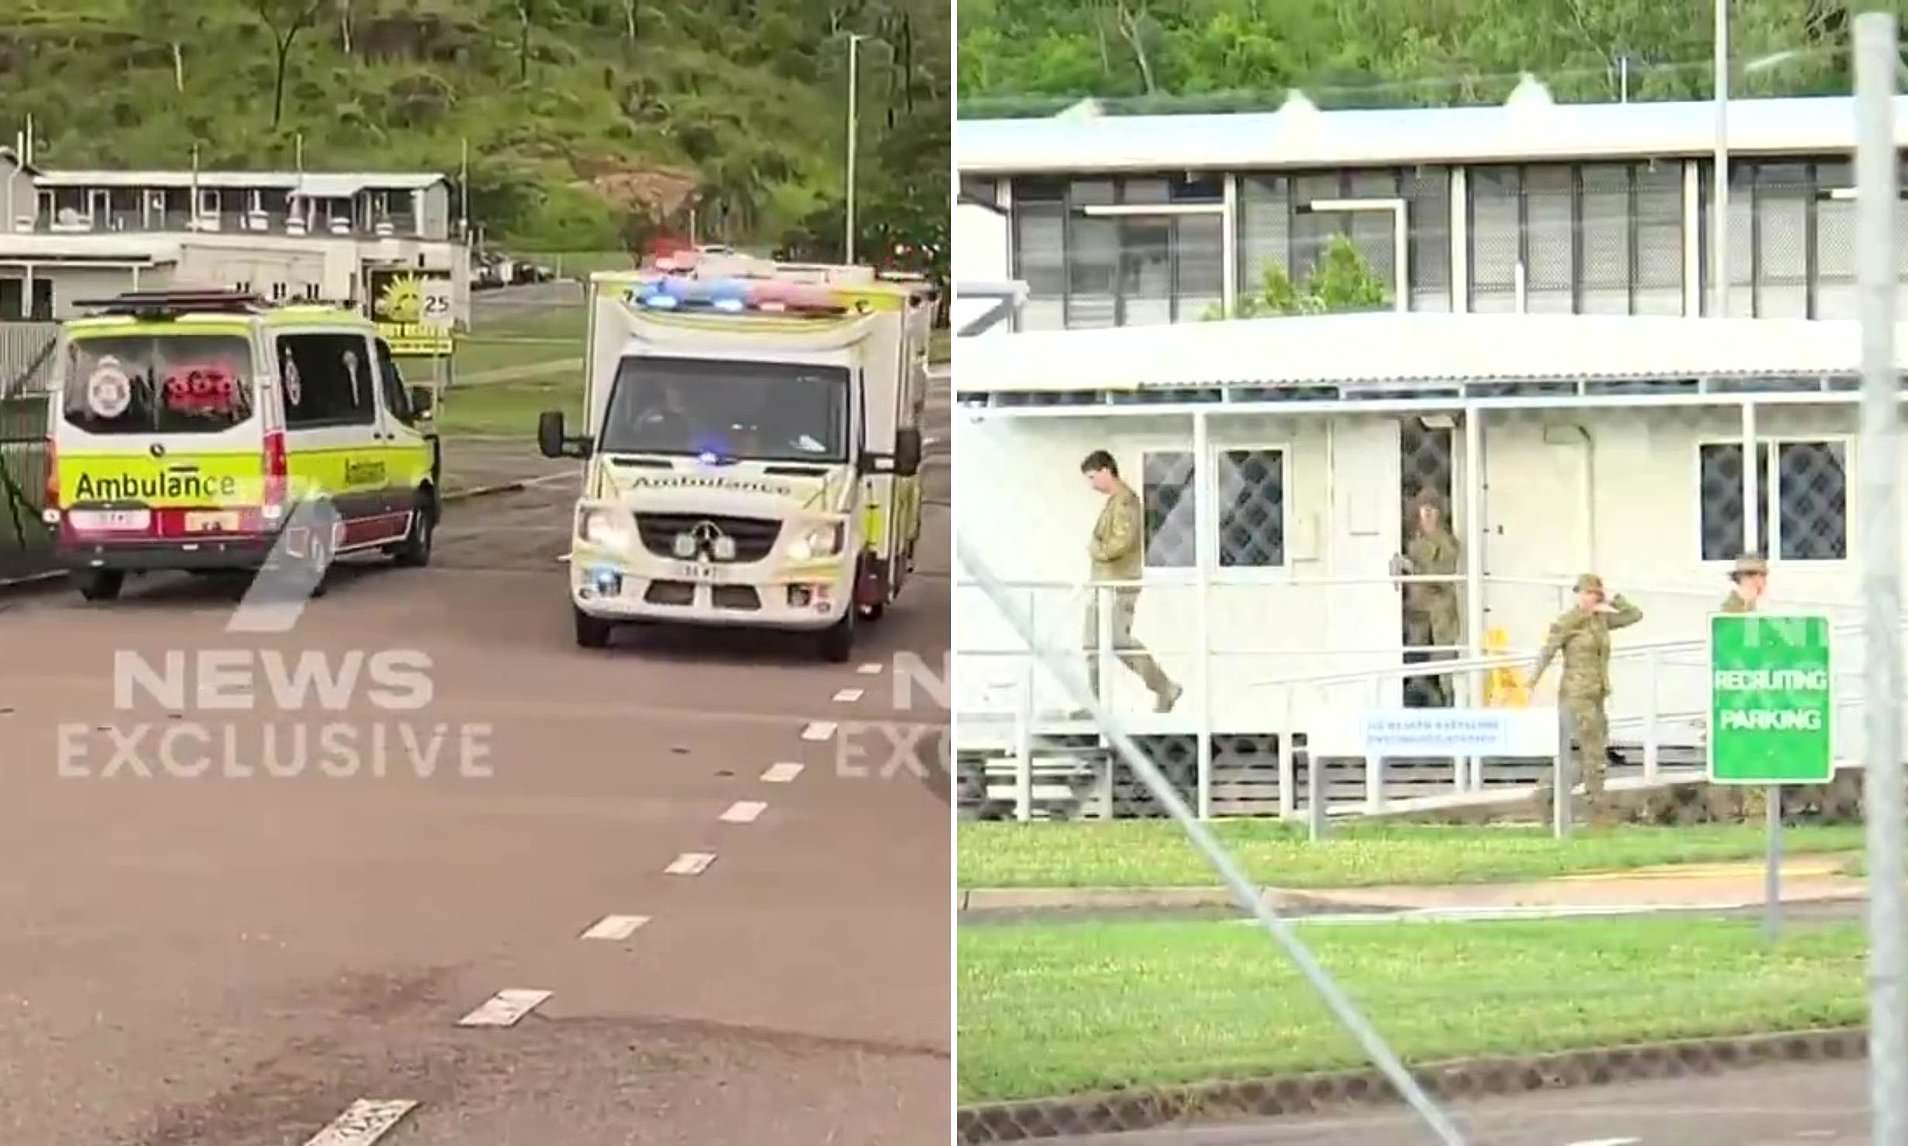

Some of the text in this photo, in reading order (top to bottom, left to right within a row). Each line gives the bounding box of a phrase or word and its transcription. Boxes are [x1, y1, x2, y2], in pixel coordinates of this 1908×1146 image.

[424, 296, 449, 312] 25
[76, 472, 236, 499] Ambulance
[631, 474, 793, 497] Ambulance
[1714, 668, 1828, 691] RECRUITING
[1719, 708, 1823, 731] PARKING
